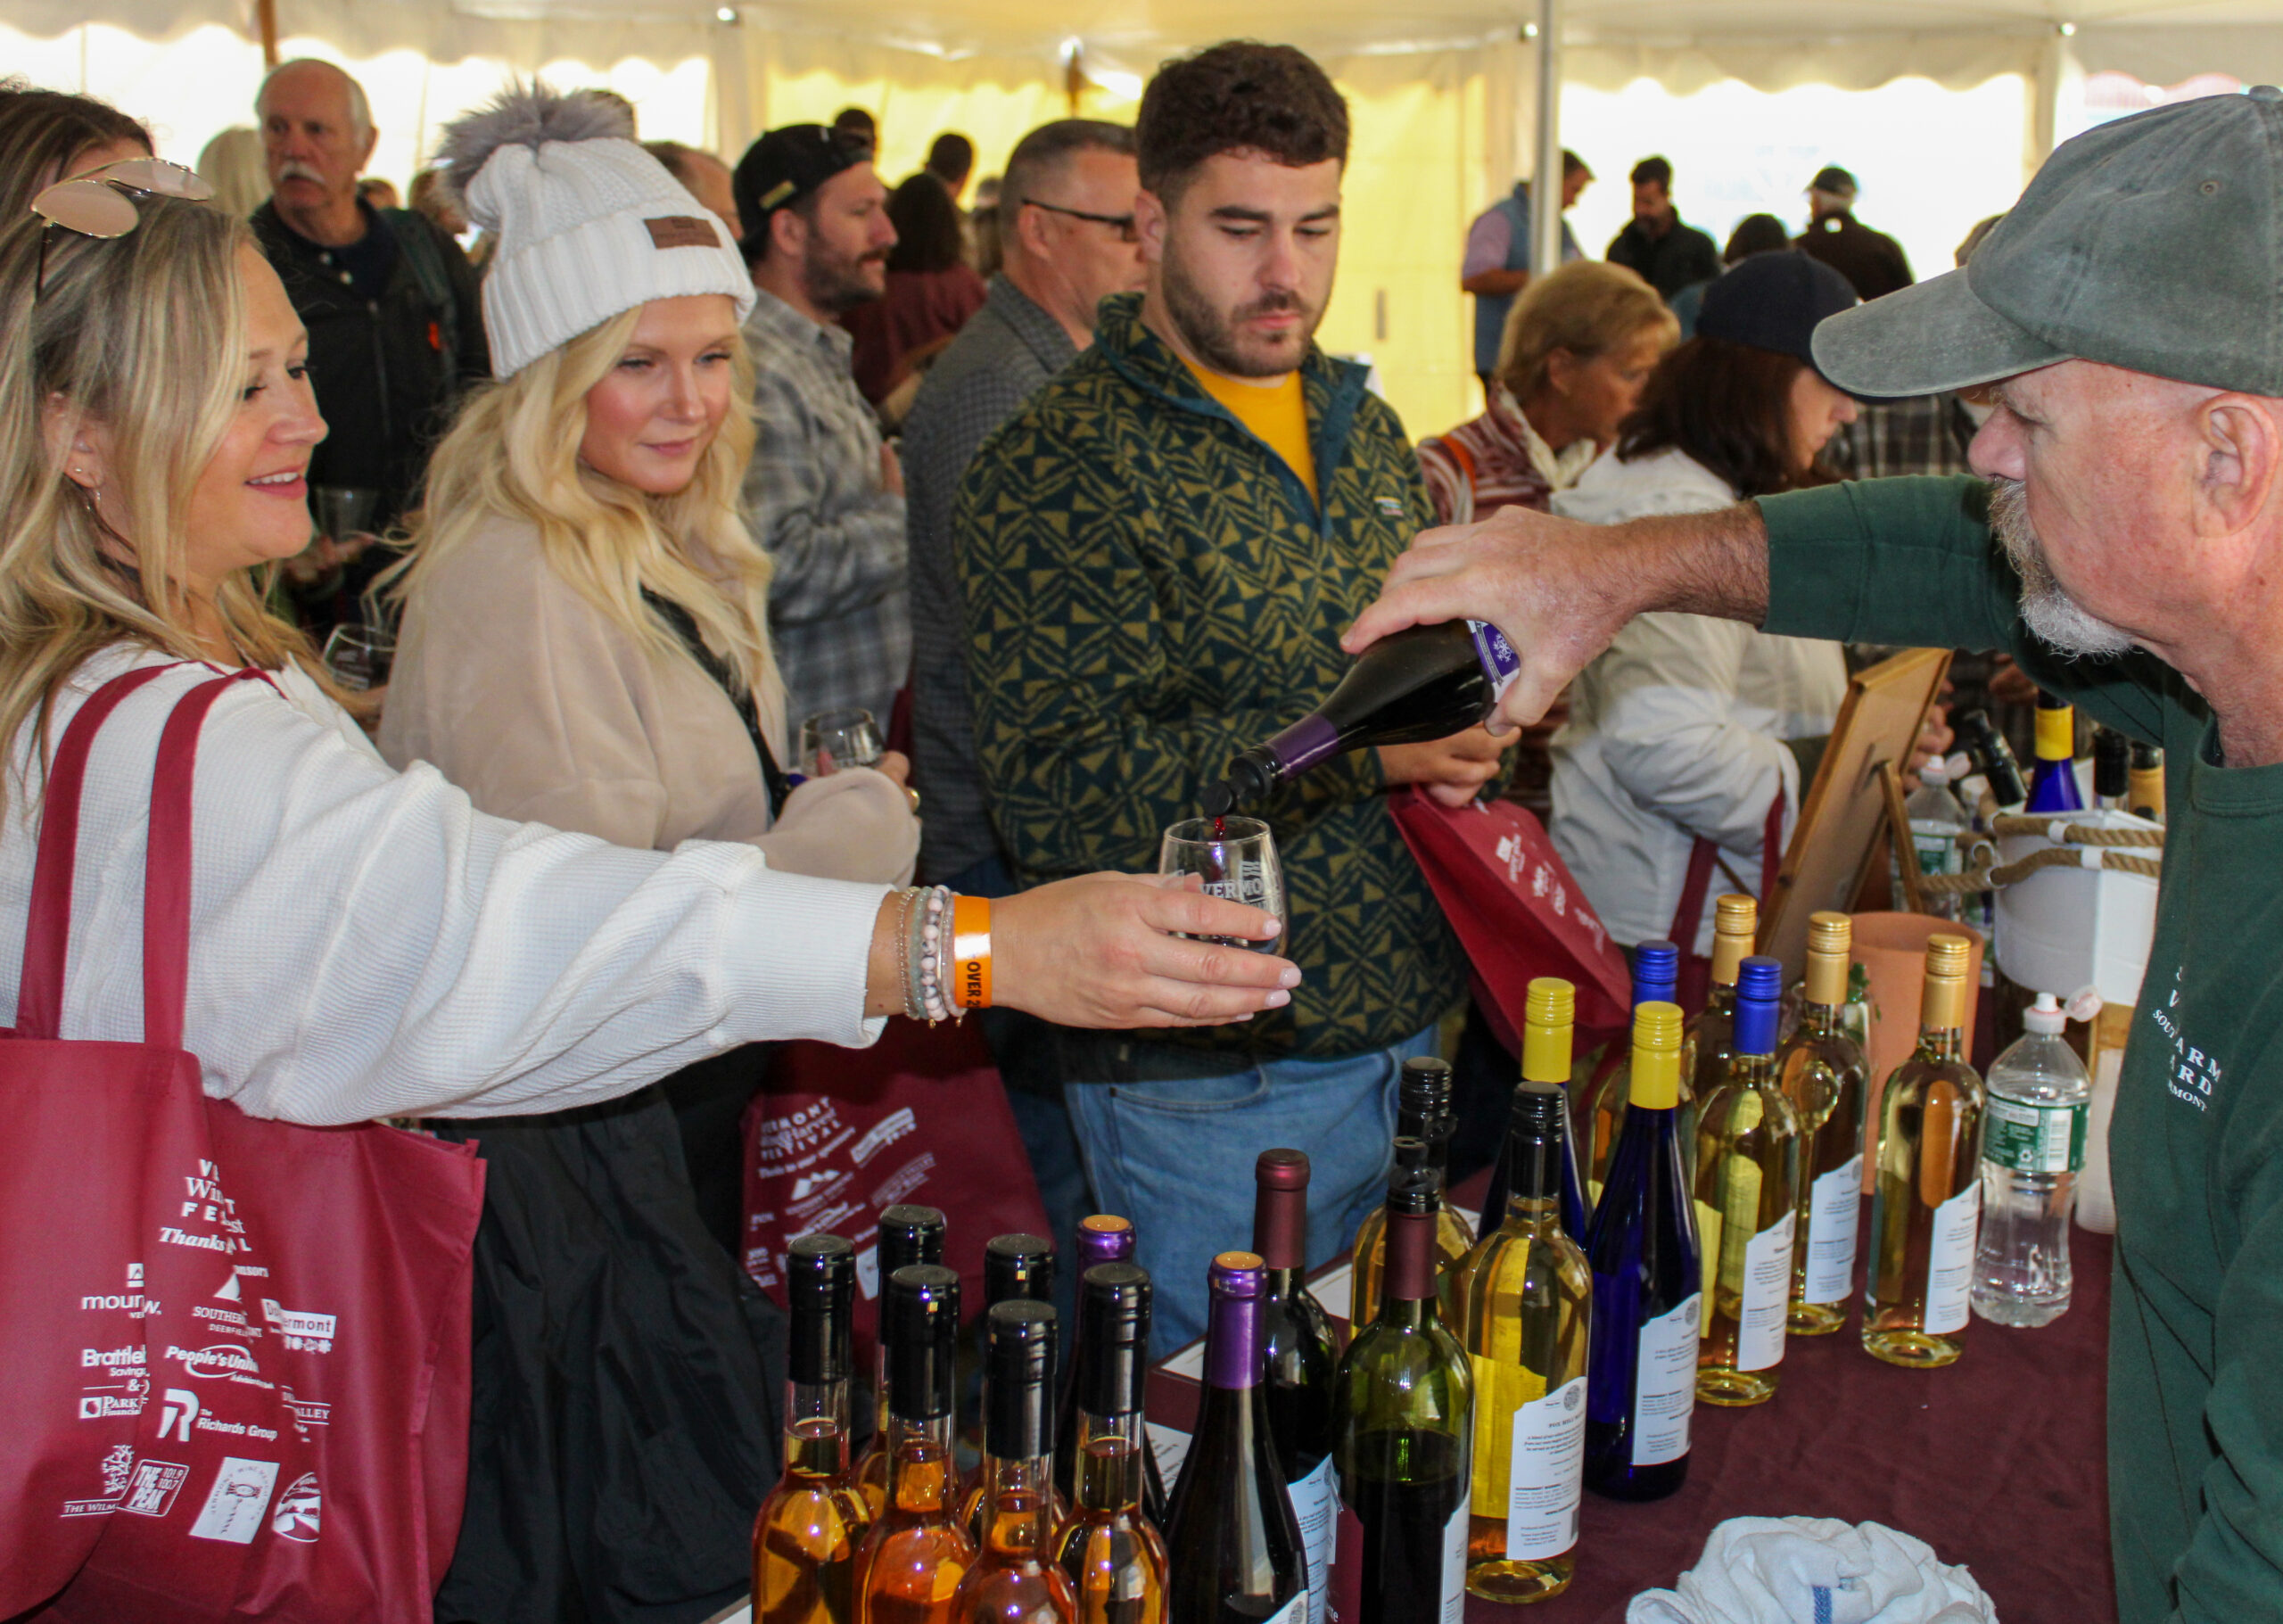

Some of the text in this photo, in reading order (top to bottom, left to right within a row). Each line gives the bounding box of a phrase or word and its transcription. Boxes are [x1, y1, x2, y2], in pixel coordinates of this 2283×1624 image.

[1199, 878, 1264, 899] VERMO
[967, 961, 982, 997] OVER
[192, 1306, 247, 1325] SOUTHER
[197, 1416, 246, 1434] Richards
[247, 1425, 279, 1442] Group
[136, 1465, 163, 1488] THE
[128, 1488, 168, 1513] PEAK
